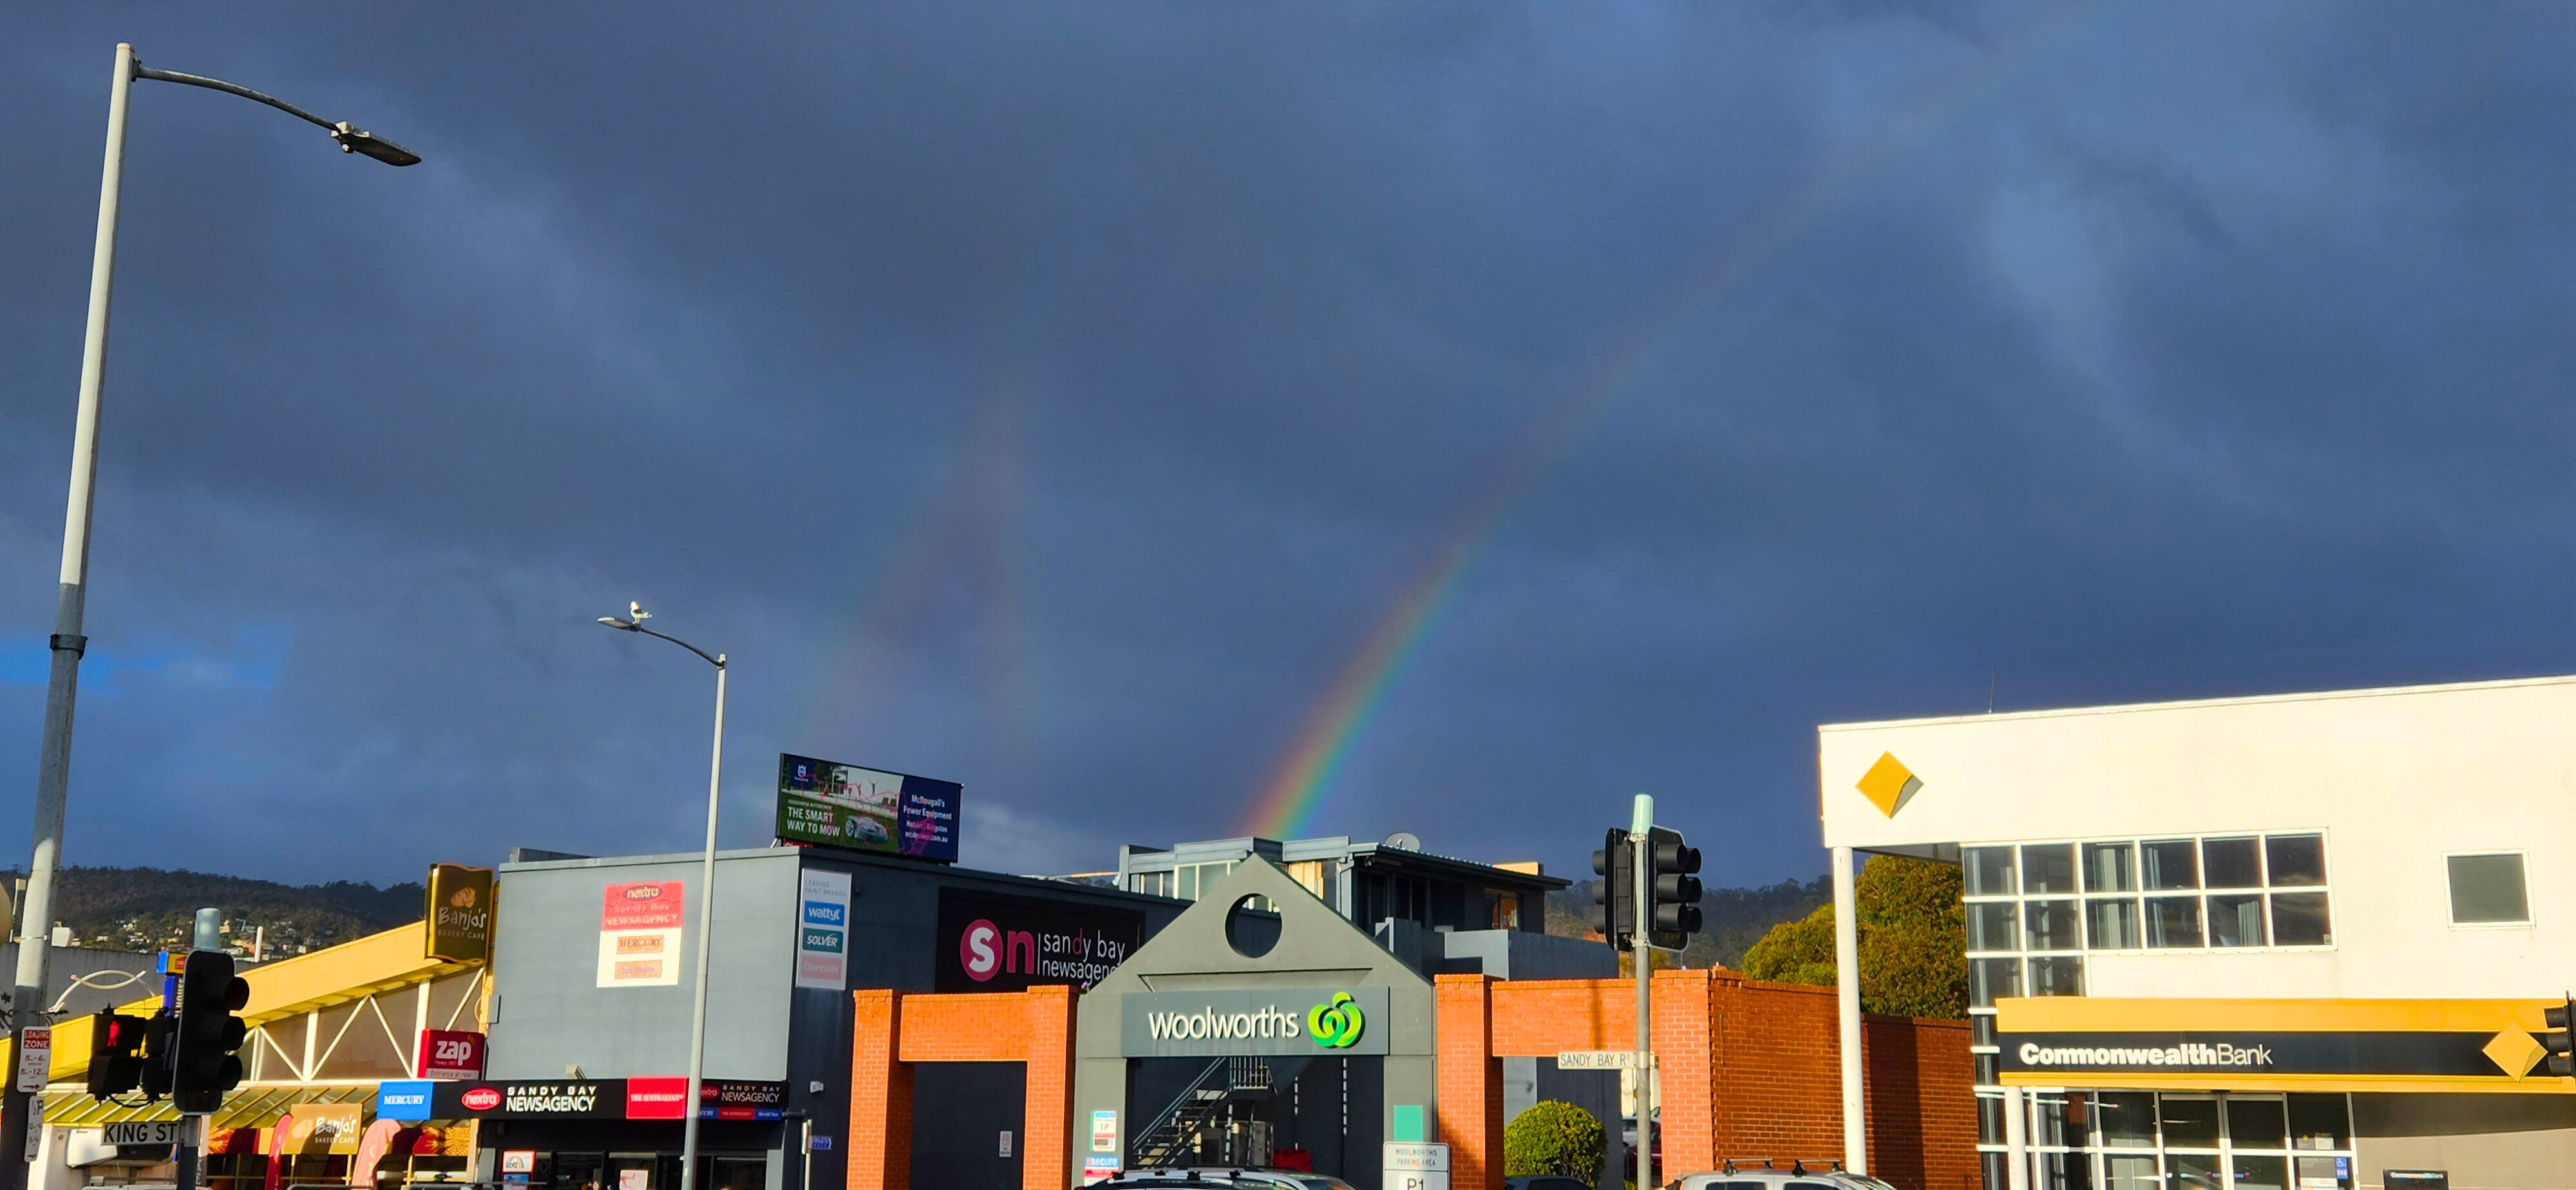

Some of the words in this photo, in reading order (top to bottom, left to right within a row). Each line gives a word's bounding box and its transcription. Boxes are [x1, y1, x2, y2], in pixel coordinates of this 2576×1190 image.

[911, 794, 945, 808] McDougall's
[788, 806, 804, 818] THE
[805, 809, 833, 823] SMART
[904, 805, 922, 816] Power
[922, 808, 952, 820] Equipment
[787, 819, 806, 832] WAY
[808, 822, 818, 834] TO
[819, 825, 840, 836] MOW
[804, 879, 830, 888] LEADING
[627, 886, 659, 899] nextra
[804, 887, 821, 895] PAINT
[823, 889, 846, 898] BRANDS
[438, 906, 487, 931] Banjo's
[605, 914, 679, 926] NEWSAGENCY
[437, 929, 465, 938] BAKERY
[467, 932, 485, 940] CAFE
[806, 934, 838, 947] SOLVER
[620, 937, 662, 947] MERCURY
[1043, 928, 1092, 963] sandy
[1097, 929, 1126, 966] bay
[1148, 1005, 1300, 1040] Woolworths
[24, 1040, 49, 1048] ZONE
[435, 1040, 472, 1066] zap
[1560, 1053, 1591, 1067] SANDY
[1597, 1053, 1615, 1067] BAY
[507, 1086, 559, 1096] SANDY
[567, 1086, 597, 1096] BAY
[721, 1091, 780, 1103] NEWSAGENCY
[383, 1095, 425, 1105] MERCURY
[465, 1093, 497, 1106] nextra
[506, 1096, 596, 1112] NEWSAGENCY
[104, 1124, 148, 1143] KING
[155, 1123, 178, 1142] ST
[315, 1115, 357, 1138] Banjo's
[1395, 1148, 1437, 1157] WOOLWORTHS
[1407, 1178, 1424, 1190] P1
